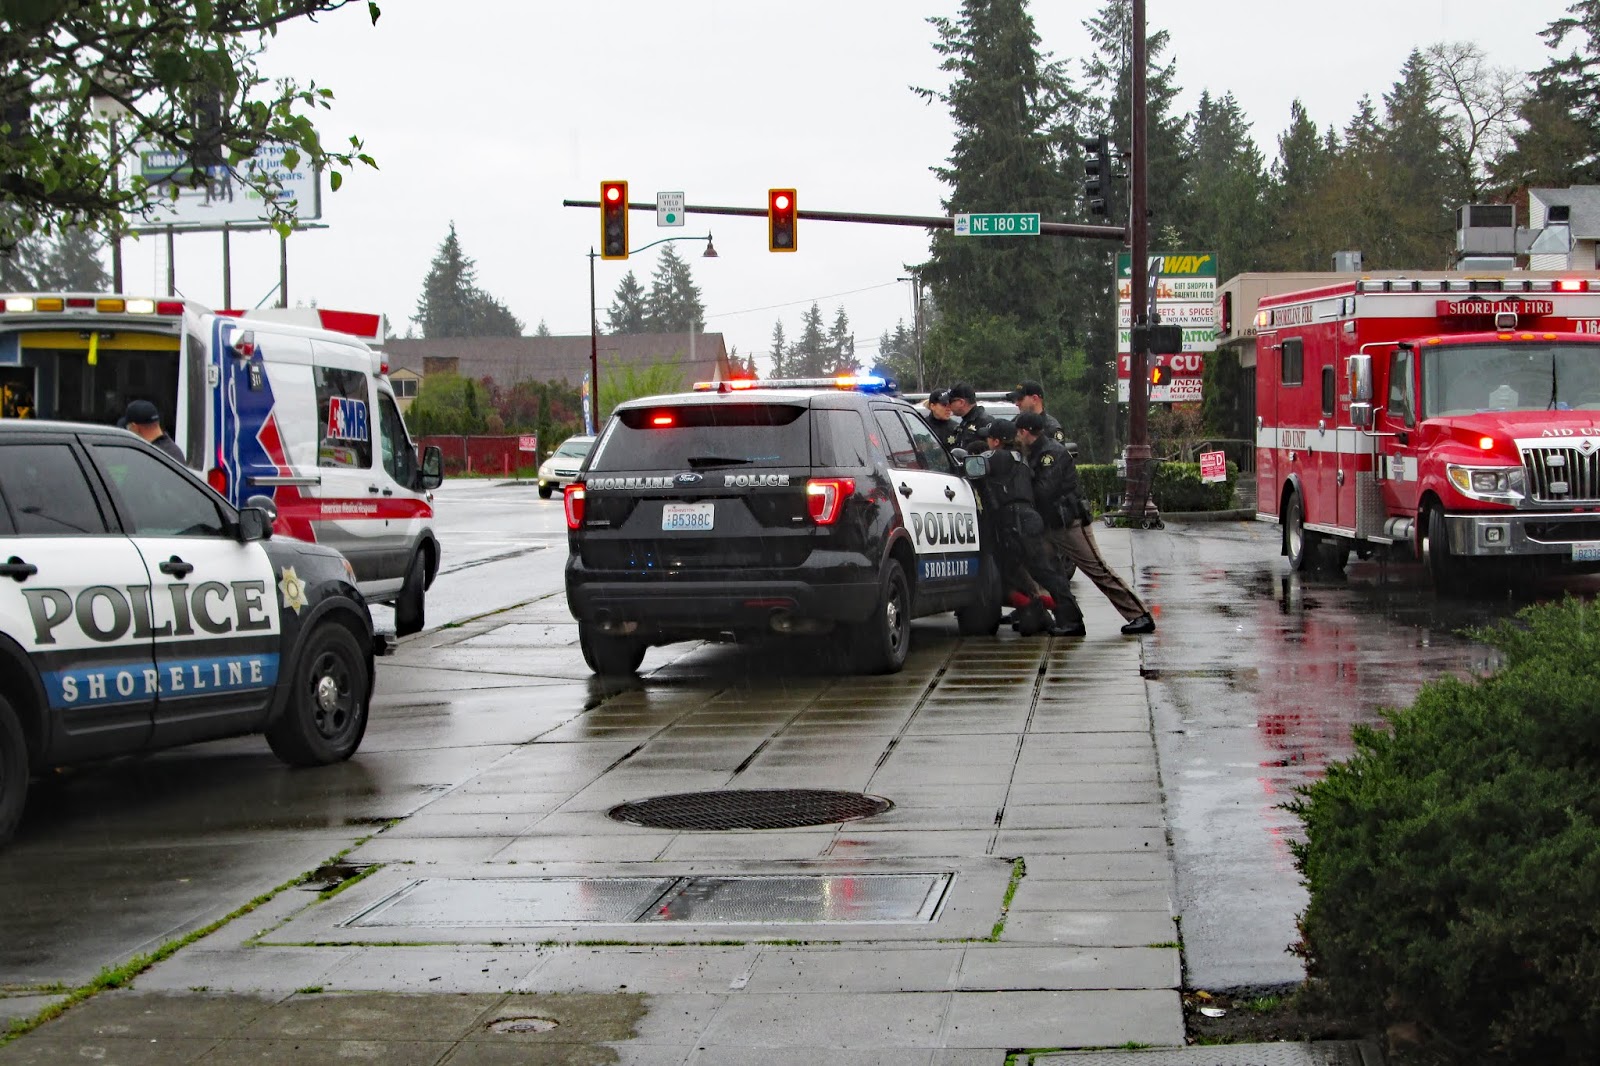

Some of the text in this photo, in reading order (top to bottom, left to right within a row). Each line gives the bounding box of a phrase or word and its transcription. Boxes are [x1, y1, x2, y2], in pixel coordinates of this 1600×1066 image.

[973, 217, 1035, 231] NE 180 ST
[1174, 282, 1186, 290] GIFT
[1174, 291, 1214, 299] ORIENTAL FOOD
[1189, 308, 1214, 316] SPICES
[1450, 301, 1553, 314] SHORELINE FIRE
[1275, 305, 1313, 327] SHORELINE FIRE
[1575, 320, 1584, 334] A
[1169, 355, 1203, 371] CU
[1174, 378, 1203, 386] INDIA
[1169, 386, 1202, 394] KITCH
[327, 396, 368, 442] AMR
[1281, 431, 1306, 448] AID UNIT
[1541, 428, 1574, 437] AID
[586, 473, 790, 490] SHORELINE Ford POLICE
[672, 513, 710, 527] B5388C
[910, 511, 976, 546] POLICE
[925, 560, 969, 578] SHORELINE
[20, 580, 271, 645] POLICE
[61, 659, 264, 702] SHORELINE
